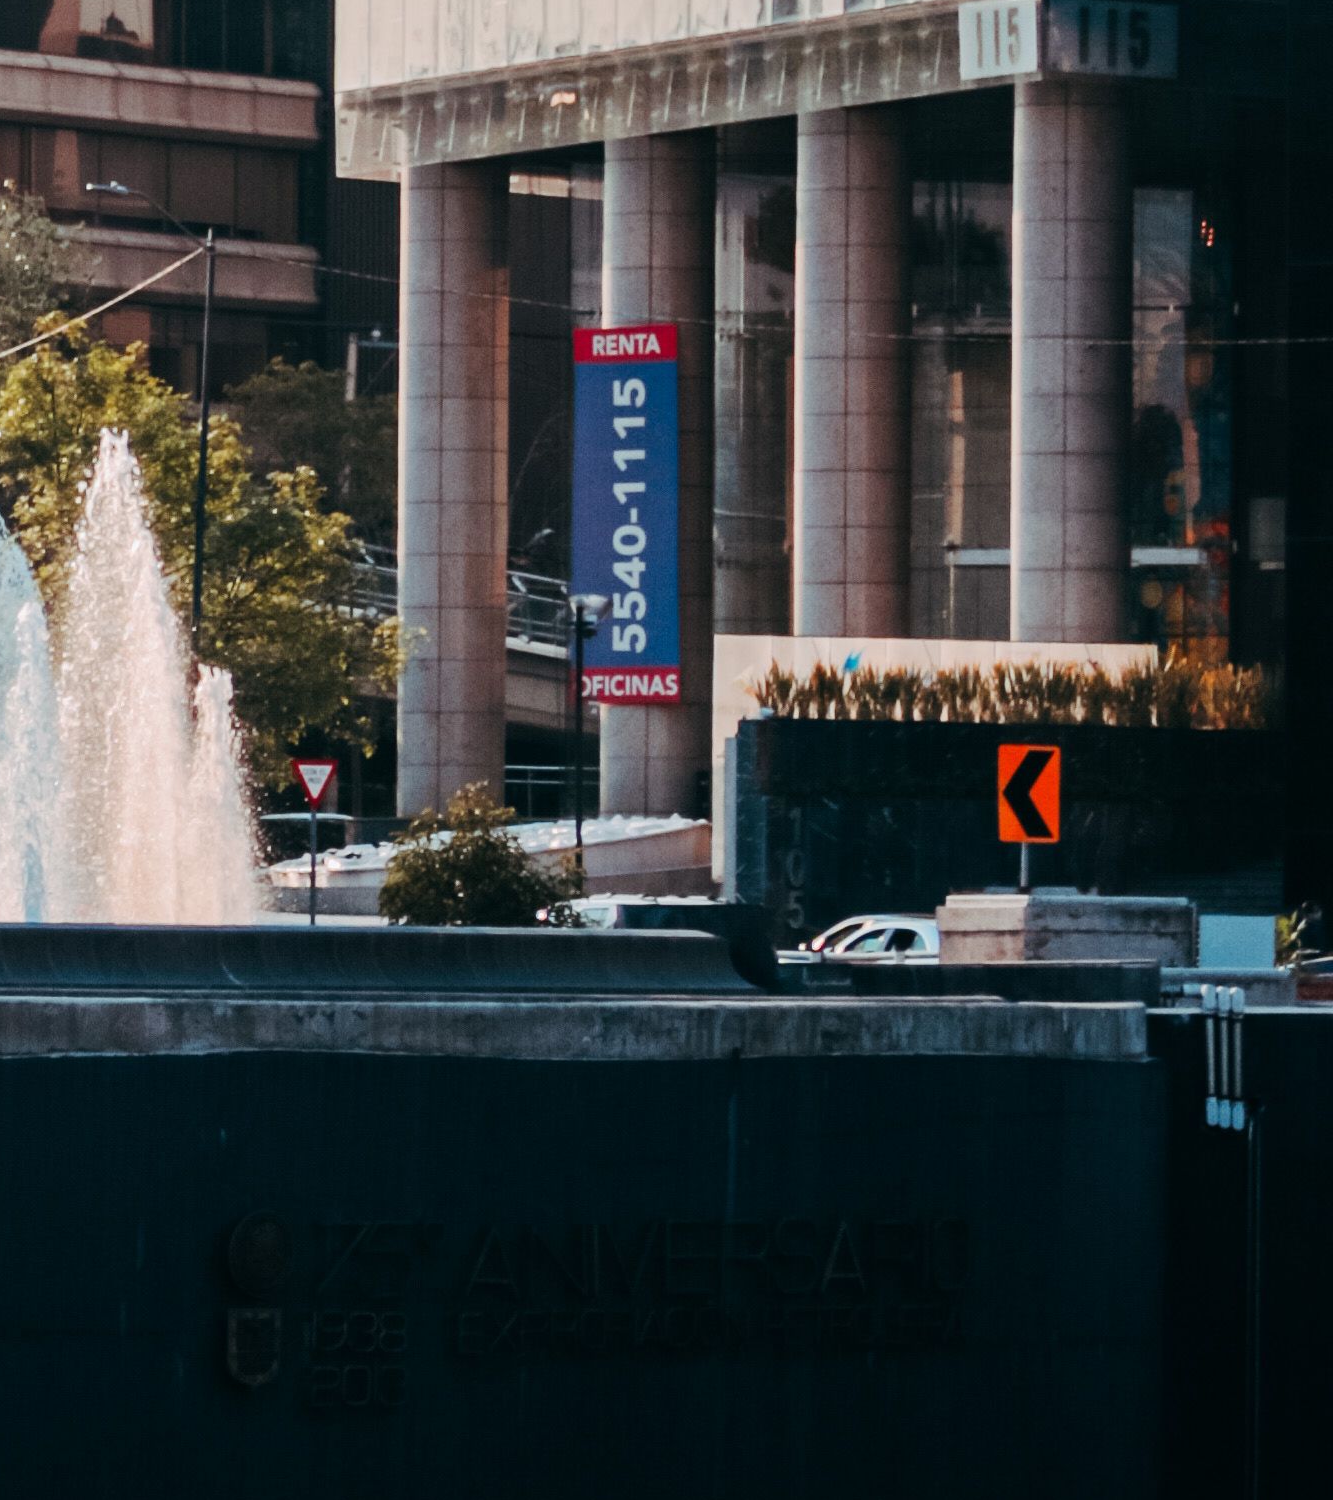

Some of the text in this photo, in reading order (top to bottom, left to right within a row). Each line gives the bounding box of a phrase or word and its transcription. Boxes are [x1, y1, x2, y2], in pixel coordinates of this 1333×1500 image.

[976, 7, 1020, 68] 115
[1079, 7, 1150, 68] 115
[592, 333, 661, 356] RENTA
[612, 378, 647, 654] 5540-1115
[464, 1215, 970, 1297] ANIVERSARIO
